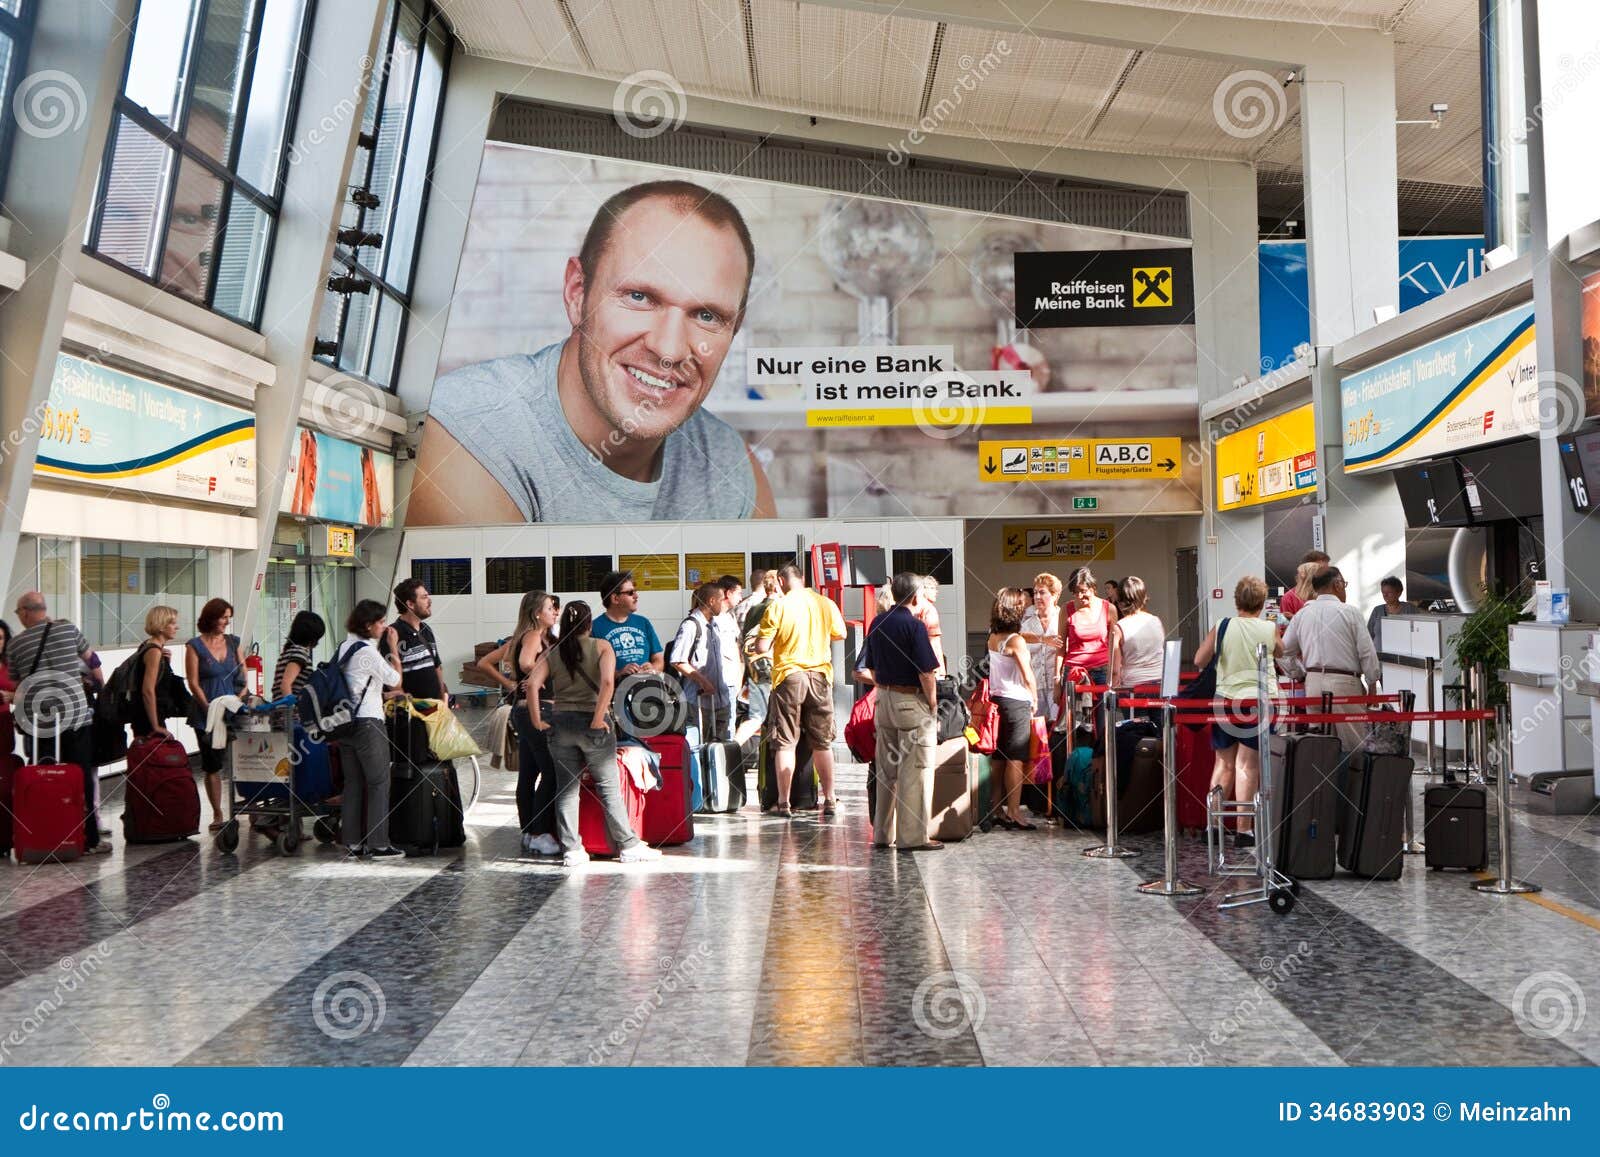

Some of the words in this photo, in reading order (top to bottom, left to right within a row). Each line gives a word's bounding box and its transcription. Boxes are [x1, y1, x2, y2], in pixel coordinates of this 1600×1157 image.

[1051, 281, 1125, 296] Raiffeisen
[1034, 296, 1081, 310] Meine
[1085, 295, 1126, 310] Bank
[756, 356, 803, 376] Nur
[811, 356, 867, 375] eine
[876, 355, 944, 374] Bank
[816, 381, 848, 400] ist
[856, 381, 939, 400] meine
[947, 380, 1022, 399] Bank.
[816, 412, 876, 423] www.raiffeisen.at
[1098, 446, 1150, 464] A,B,C
[1030, 462, 1043, 473] WC
[1096, 466, 1153, 475] Flugsteige/Gates
[1570, 476, 1589, 508] 16
[1055, 545, 1069, 555] WC
